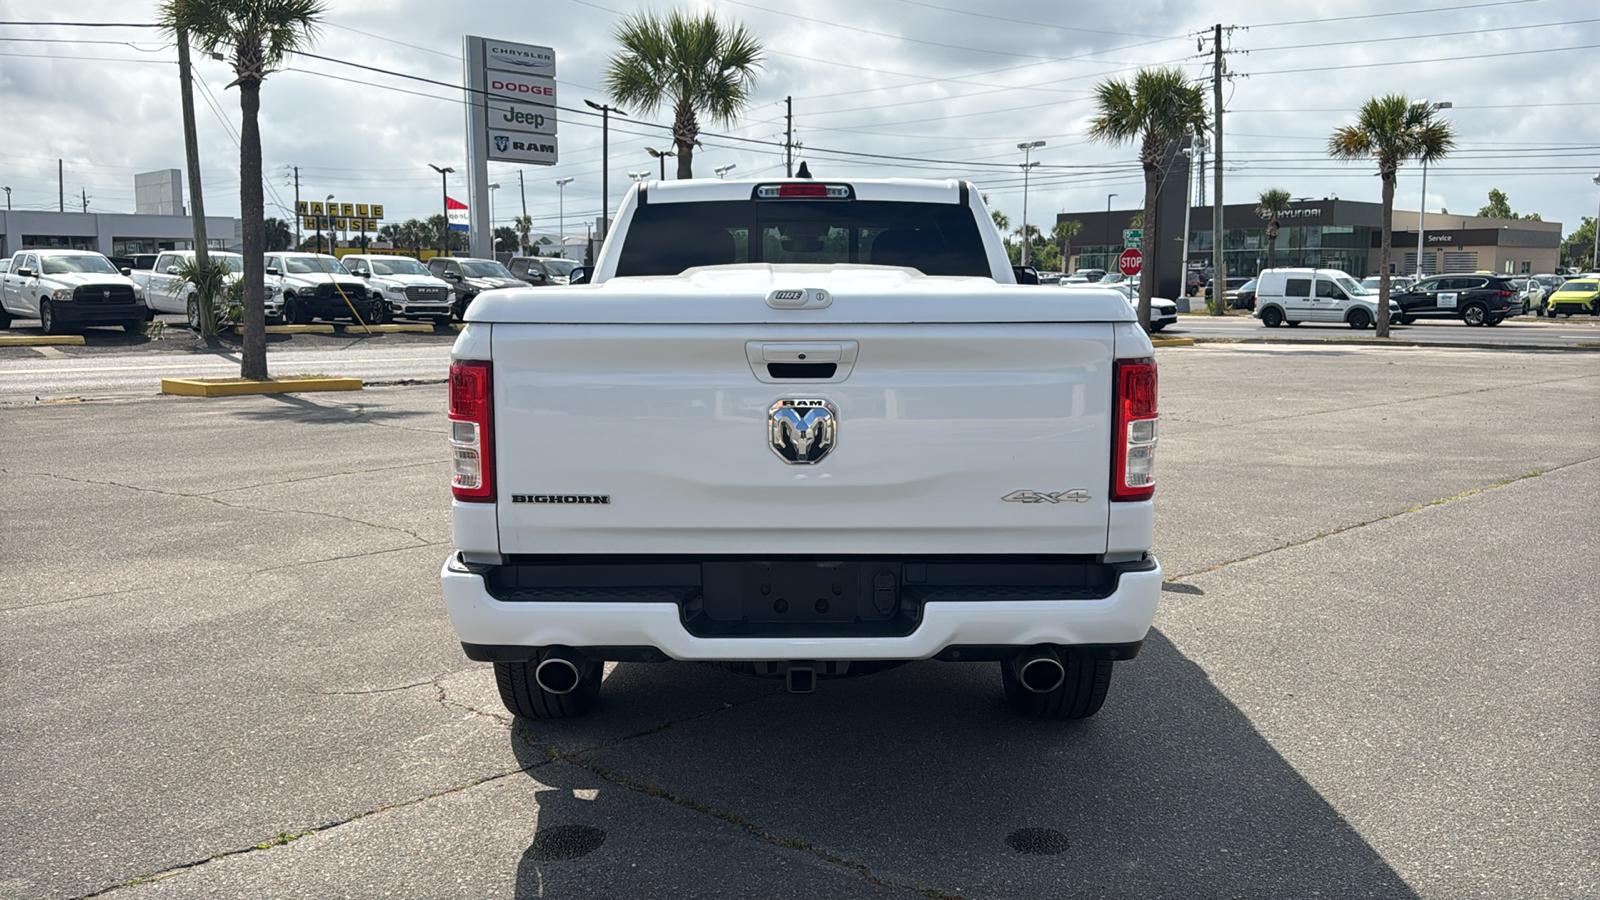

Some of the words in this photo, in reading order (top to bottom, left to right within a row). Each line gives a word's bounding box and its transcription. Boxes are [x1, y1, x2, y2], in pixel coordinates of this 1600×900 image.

[492, 47, 551, 60] CHRYSLER
[492, 80, 554, 96] DODGE
[503, 106, 545, 129] Jeep
[513, 141, 555, 153] RAM
[299, 203, 382, 216] WAFFLE
[1277, 209, 1321, 219] HYUNDAI
[1428, 234, 1452, 242] Service
[1121, 256, 1142, 268] STOP
[512, 495, 609, 504] BIGHORN
